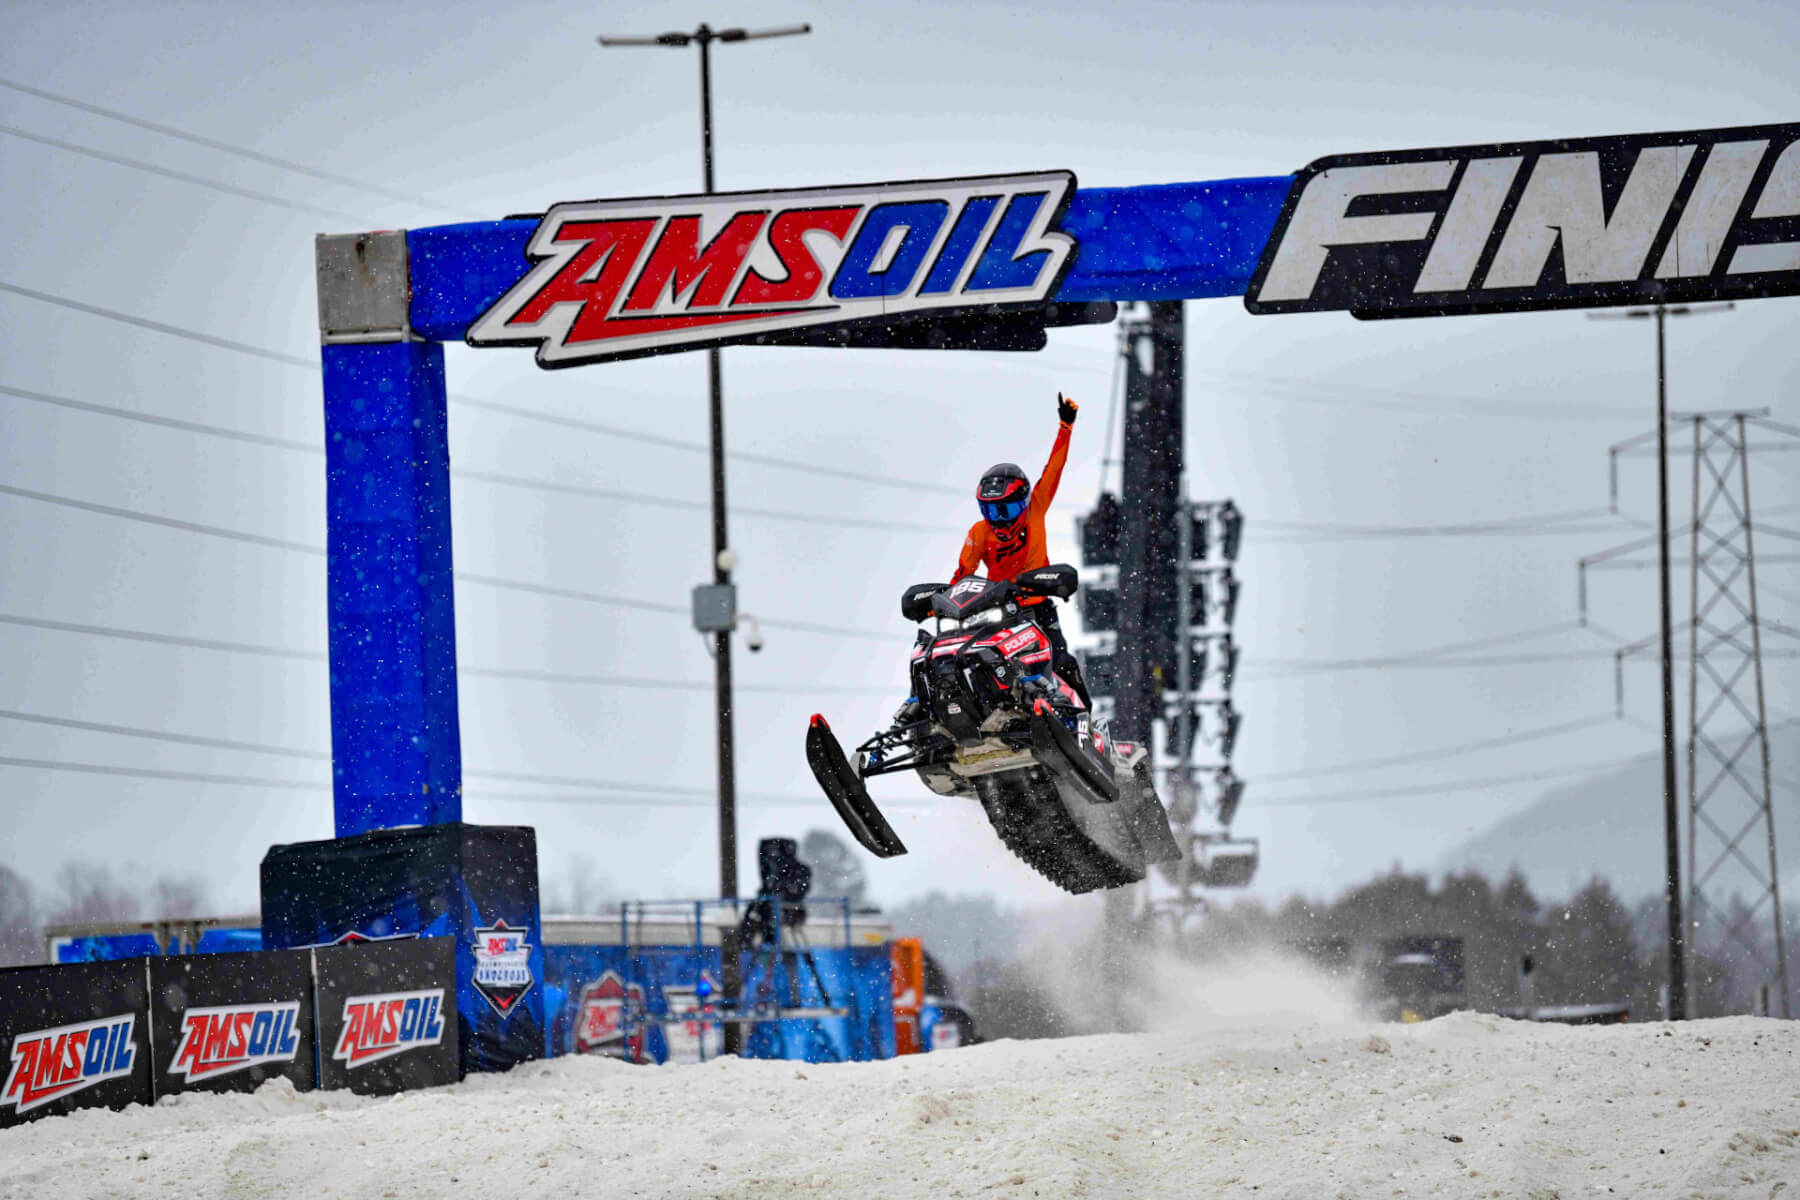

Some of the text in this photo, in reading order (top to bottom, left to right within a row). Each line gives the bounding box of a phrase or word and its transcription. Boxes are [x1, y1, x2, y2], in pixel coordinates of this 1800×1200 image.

[502, 189, 1057, 348] AMSOIL
[6, 1021, 133, 1105] AMSOIL
[176, 1009, 297, 1076] AMSOIL
[339, 995, 441, 1062] AMSOIL
